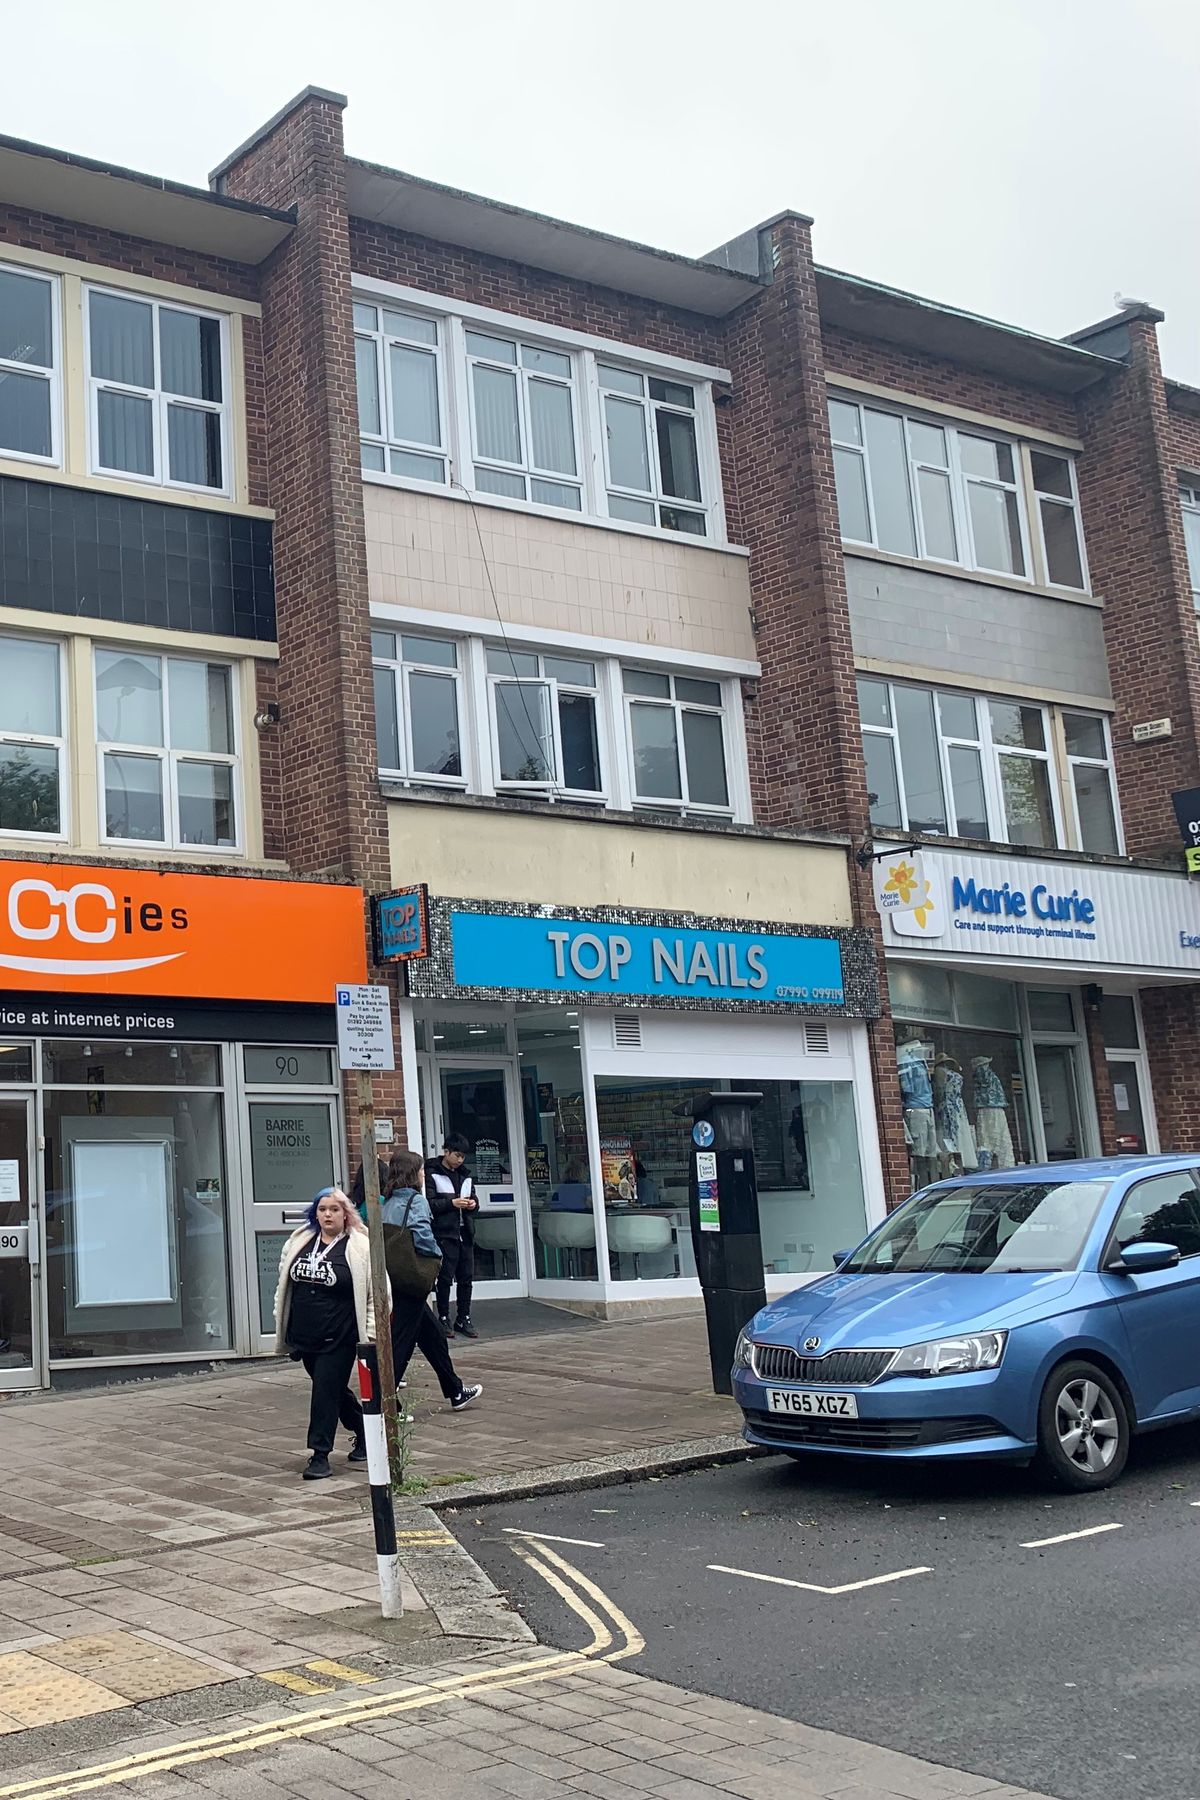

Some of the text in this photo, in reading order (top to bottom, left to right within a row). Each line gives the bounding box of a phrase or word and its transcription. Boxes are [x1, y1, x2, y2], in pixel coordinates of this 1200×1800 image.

[1188, 820, 1200, 834] 0
[880, 892, 898, 900] Marie
[952, 876, 1095, 924] Marie Curie
[384, 904, 416, 928] TOP
[384, 926, 416, 946] NAILS
[954, 919, 1096, 940] Care and support through terminal illness
[548, 931, 768, 990] TOP NAILS
[340, 992, 348, 1004] P
[776, 985, 808, 998] 07990
[32, 1012, 49, 1025] at
[54, 1010, 120, 1027] internet
[126, 1013, 174, 1030] prices
[275, 1056, 298, 1076] 90
[266, 1118, 304, 1132] BARRIE
[266, 1134, 311, 1147] SIMONS
[1, 1236, 18, 1248] 90
[298, 1262, 326, 1272] STELA
[772, 1392, 850, 1415] FY65 XGZ
